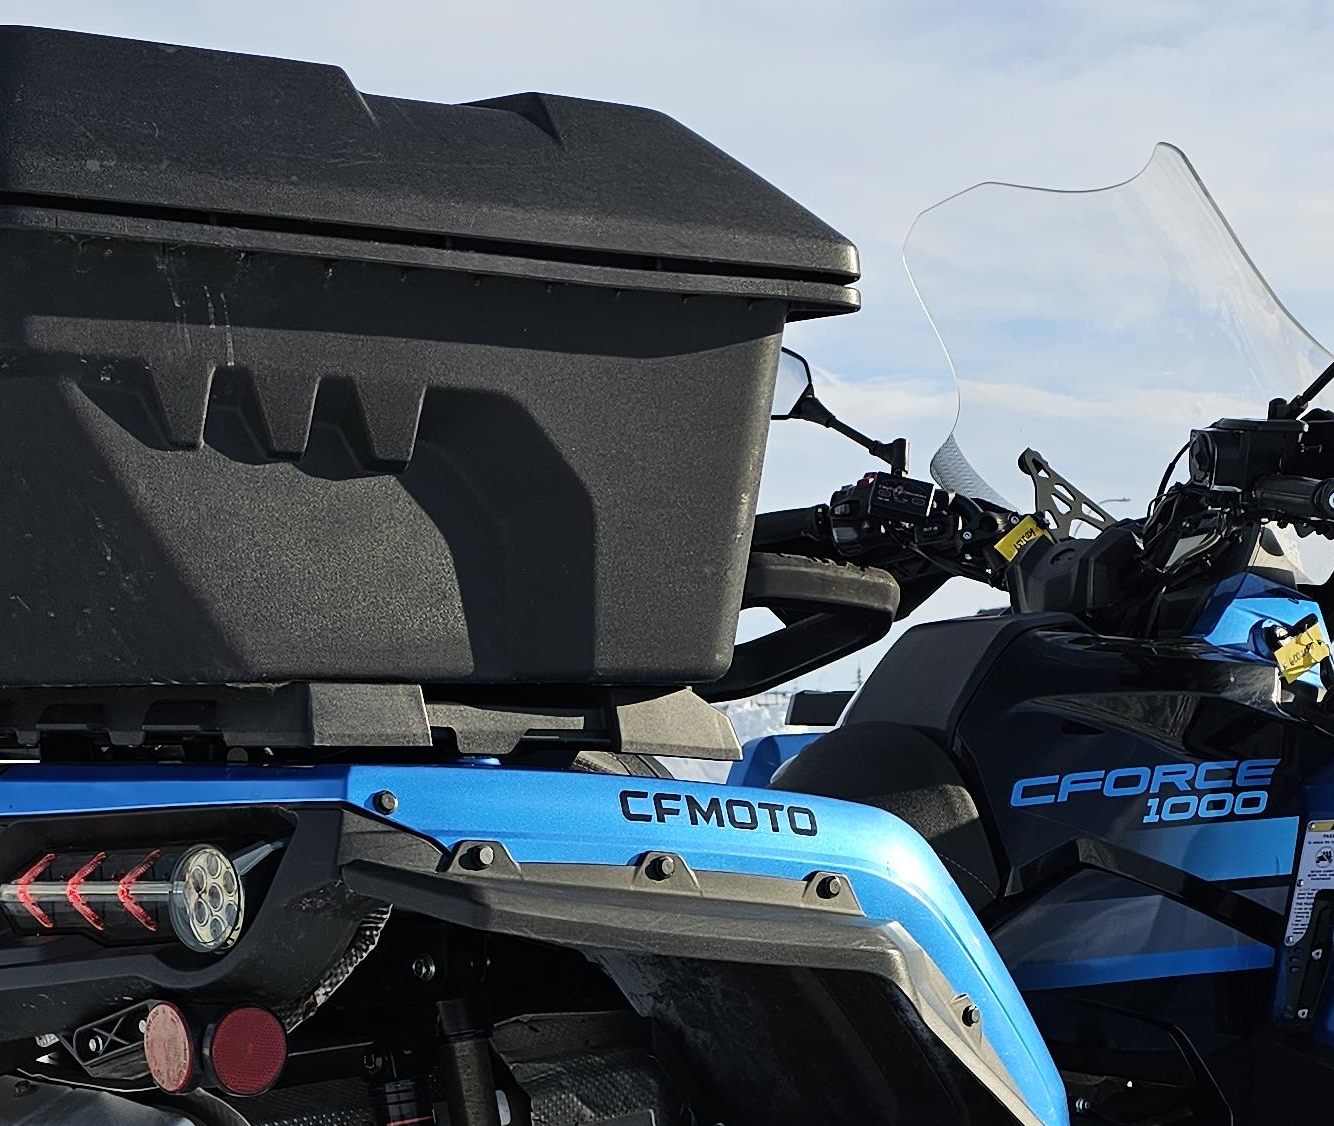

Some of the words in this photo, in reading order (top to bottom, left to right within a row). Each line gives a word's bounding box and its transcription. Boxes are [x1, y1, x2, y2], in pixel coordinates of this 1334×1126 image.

[1010, 758, 1282, 807] CFORCE
[619, 789, 818, 837] CFMOTO
[1142, 790, 1268, 824] 1000
